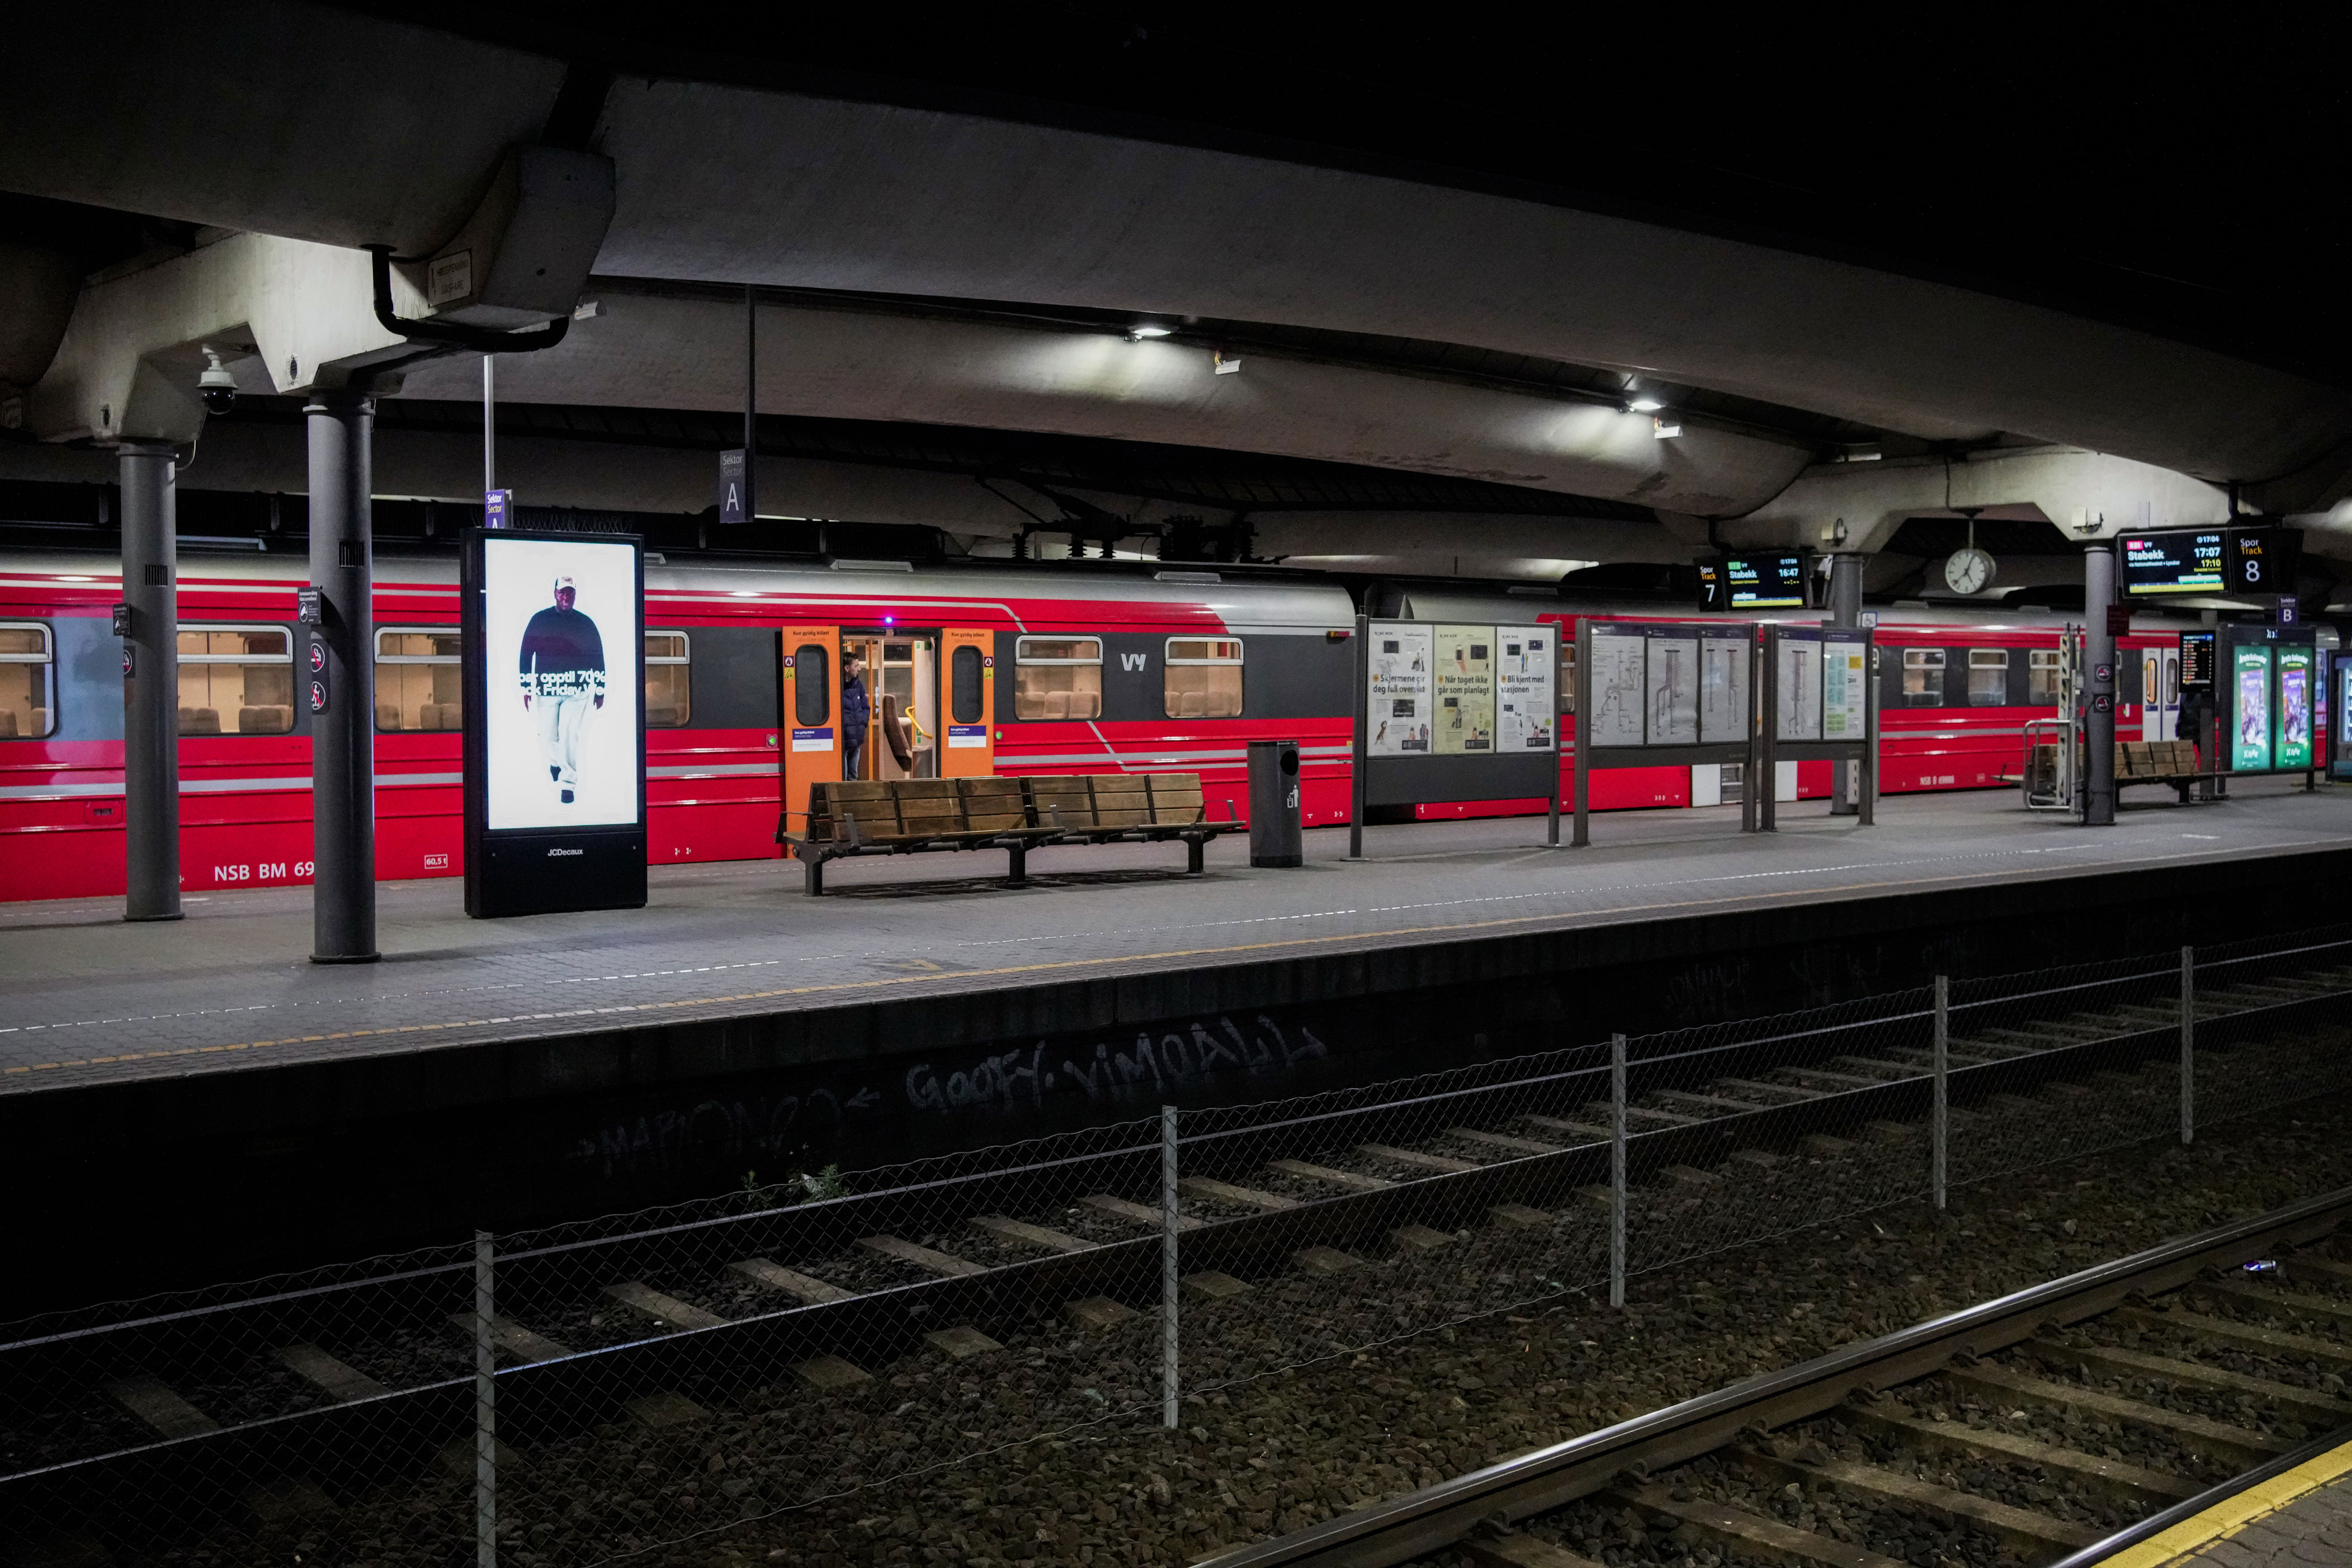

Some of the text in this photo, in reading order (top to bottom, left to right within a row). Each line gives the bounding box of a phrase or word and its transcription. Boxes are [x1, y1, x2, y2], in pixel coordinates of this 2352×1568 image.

[723, 455, 743, 465] Sektor
[723, 467, 742, 476] Sector
[487, 493, 502, 504] Sektor
[726, 483, 739, 512] A
[488, 504, 502, 514] Sector
[2240, 537, 2259, 548] Spor
[2128, 549, 2165, 561] Stabekk
[2194, 546, 2221, 558] 17:07
[2240, 546, 2263, 555] Track
[2201, 559, 2221, 568] 17:10
[1729, 569, 1758, 579] Stabekk
[1778, 568, 1799, 577] 16:47
[2246, 560, 2260, 582] 8
[1705, 584, 1715, 602] 7
[2283, 608, 2292, 622] B
[540, 670, 575, 686] opptil
[577, 670, 606, 683] 70%
[1381, 674, 1415, 684] Skjermene
[1445, 675, 1456, 683] Når
[1457, 676, 1474, 685] toget
[1516, 675, 1531, 684] kjent
[1373, 684, 1386, 695] deg
[1387, 684, 1398, 693] full
[1438, 686, 1448, 696] går
[1464, 686, 1489, 696] planlagt
[1501, 685, 1529, 695] stasjonen
[547, 848, 583, 857] JCDecaux
[426, 857, 442, 866] 60,5
[214, 861, 314, 881] NSB BM 69
